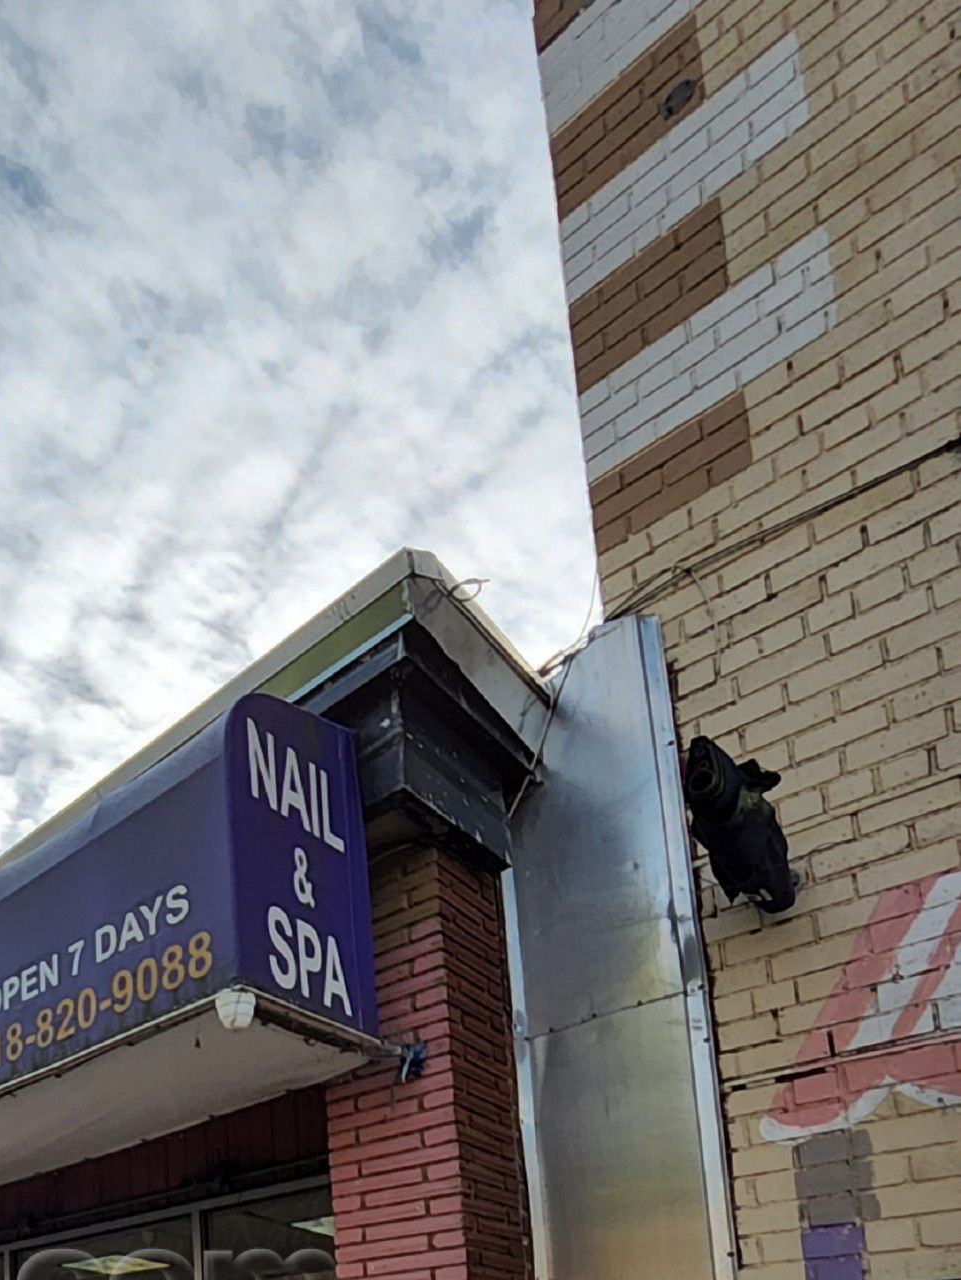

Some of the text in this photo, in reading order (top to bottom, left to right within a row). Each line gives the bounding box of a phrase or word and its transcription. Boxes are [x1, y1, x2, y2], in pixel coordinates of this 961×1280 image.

[247, 717, 345, 854] NAIL
[293, 847, 316, 909] &
[67, 941, 86, 977] 7
[95, 885, 190, 964] DAYS
[267, 905, 353, 1018] SPA
